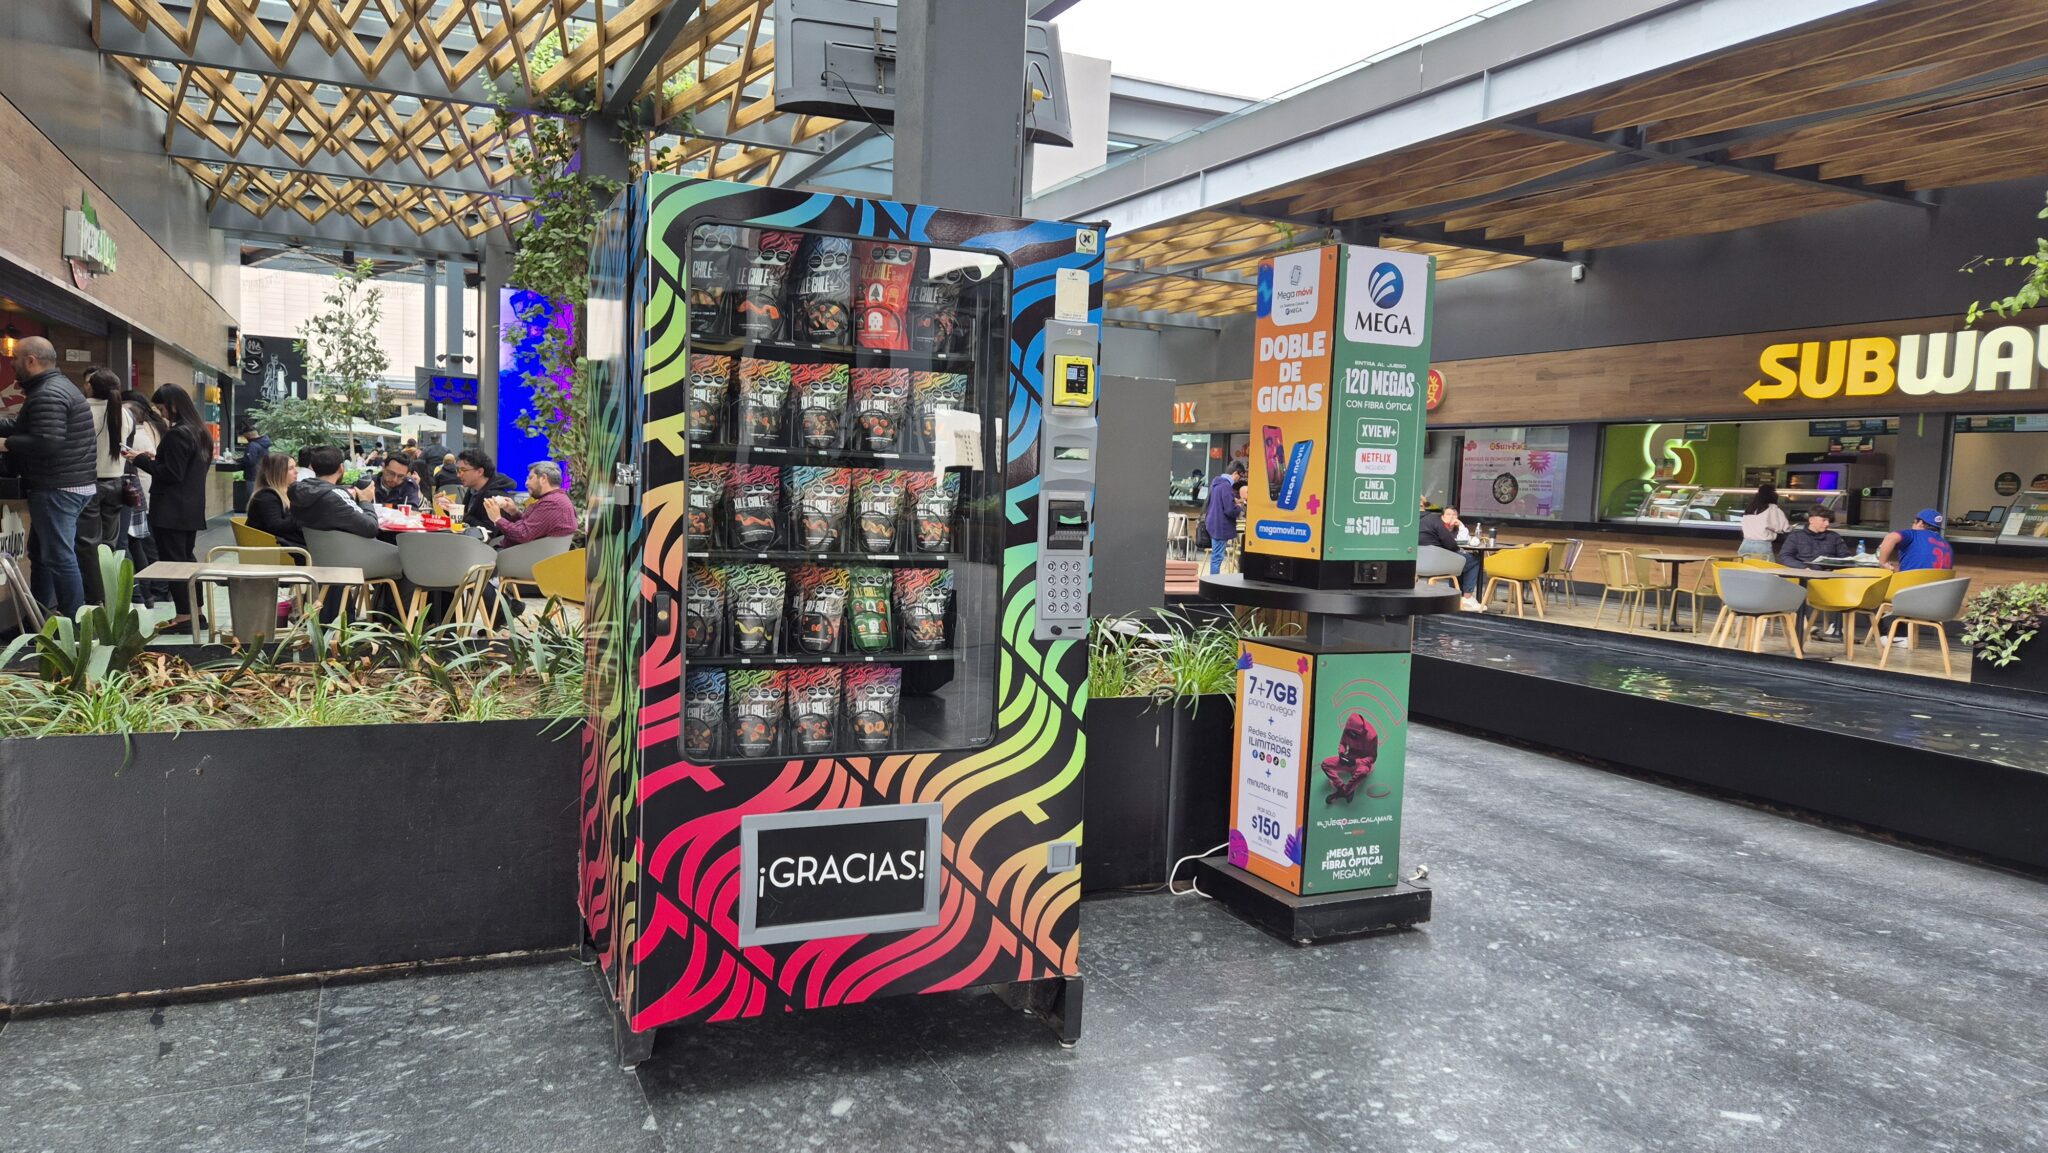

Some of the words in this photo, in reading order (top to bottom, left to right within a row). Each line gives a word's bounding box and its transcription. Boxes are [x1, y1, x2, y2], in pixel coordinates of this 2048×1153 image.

[692, 260, 713, 279] CHILE
[748, 267, 770, 286] CHILE
[811, 276, 830, 293] CHILE
[1355, 311, 1412, 335] MEGA
[1260, 331, 1326, 362] DOBLE
[1279, 361, 1302, 383] DE
[1743, 325, 2048, 405] SUBWA
[1345, 368, 1369, 395] 120
[1371, 370, 1416, 398] MEGAS
[873, 400, 890, 413] CHILE
[1257, 384, 1323, 412] GIGAS
[1346, 400, 1363, 409] CON
[1364, 401, 1384, 410] FIBRA
[1386, 401, 1412, 411] ÓPTICA
[1174, 401, 1197, 424] IX
[1362, 424, 1397, 438] XVIEW+
[1361, 452, 1392, 464] NETFLIX
[1365, 479, 1384, 490] LÍNEA
[747, 495, 766, 509] CHILE
[1359, 490, 1388, 501] CELULAR
[1259, 525, 1307, 536] megamovil.mx
[1356, 516, 1380, 536] $510
[1249, 676, 1297, 706] 7+7GB
[751, 704, 768, 718] CHILE
[1248, 698, 1265, 709] para
[1266, 702, 1296, 717] navegar
[1248, 726, 1266, 738] Redes
[1267, 732, 1293, 747] Sociales
[1252, 814, 1280, 840] $150
[1356, 846, 1367, 856] YA
[1369, 845, 1380, 854] ES
[759, 850, 925, 898] ¡GRACIAS!
[1322, 859, 1347, 871] FIBRA
[1333, 867, 1371, 880] MEGA.MX
